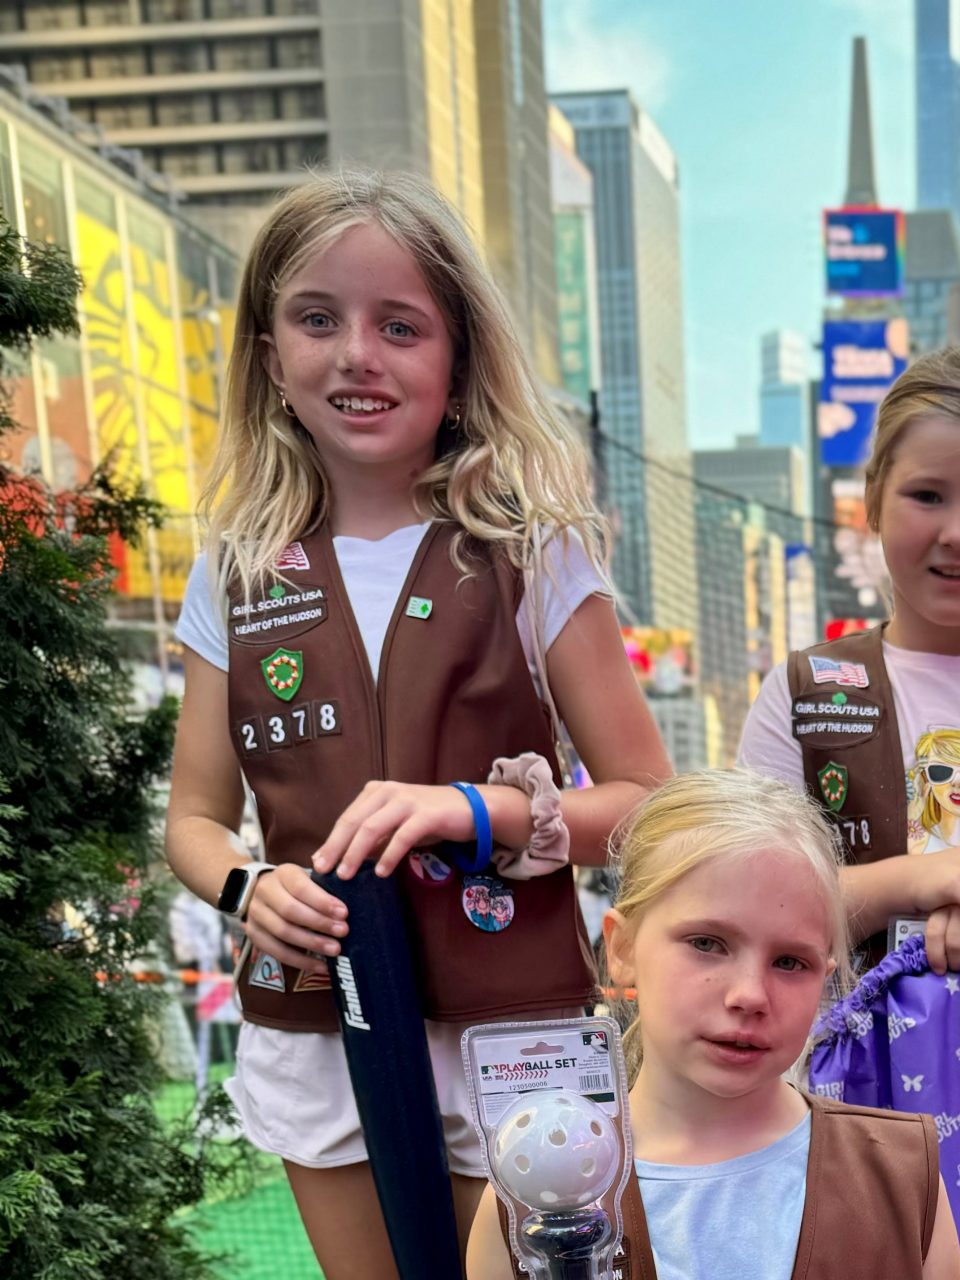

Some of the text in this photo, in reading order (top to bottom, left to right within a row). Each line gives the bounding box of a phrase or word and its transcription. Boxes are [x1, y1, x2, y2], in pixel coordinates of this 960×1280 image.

[232, 589, 324, 617] GIRL SCOUTS USA
[235, 608, 322, 636] HEART OF THE HUDSON
[796, 703, 880, 717] GIRL SCOUTS USA
[241, 703, 336, 750] 2378
[796, 723, 874, 735] HEART OF THE HUDSON
[555, 1058, 578, 1069] SET
